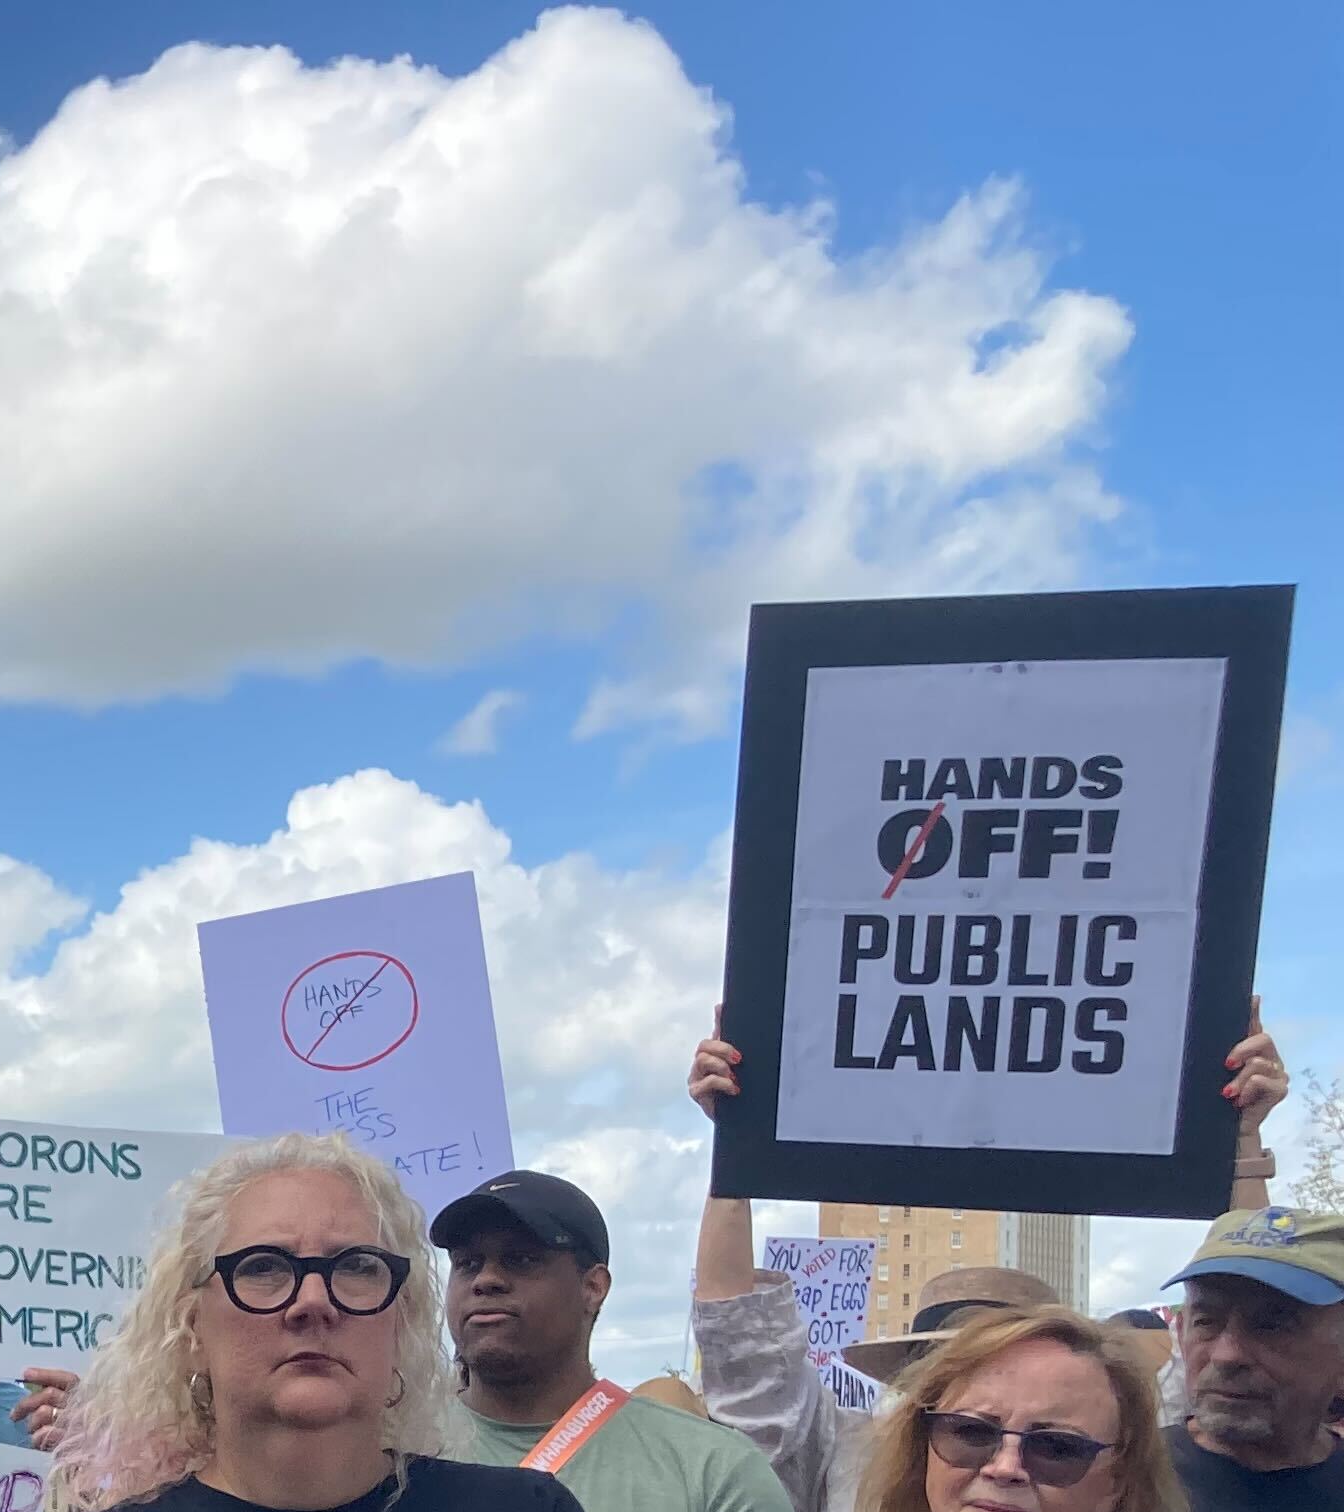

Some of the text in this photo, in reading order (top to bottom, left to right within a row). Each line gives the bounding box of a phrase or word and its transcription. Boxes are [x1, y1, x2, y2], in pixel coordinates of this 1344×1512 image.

[880, 755, 1124, 802] HANDS
[877, 806, 1121, 880] OFF!
[839, 913, 1138, 988] PUBLIC
[304, 977, 383, 1010] HANDS
[319, 1004, 363, 1030] OFF
[833, 994, 1128, 1075] LANDS
[314, 1087, 378, 1121] THE
[315, 1113, 397, 1142] SS
[768, 1245, 869, 1279] YOU VOTED FOR
[830, 1282, 868, 1311] EGGS
[808, 1319, 846, 1346] GOT
